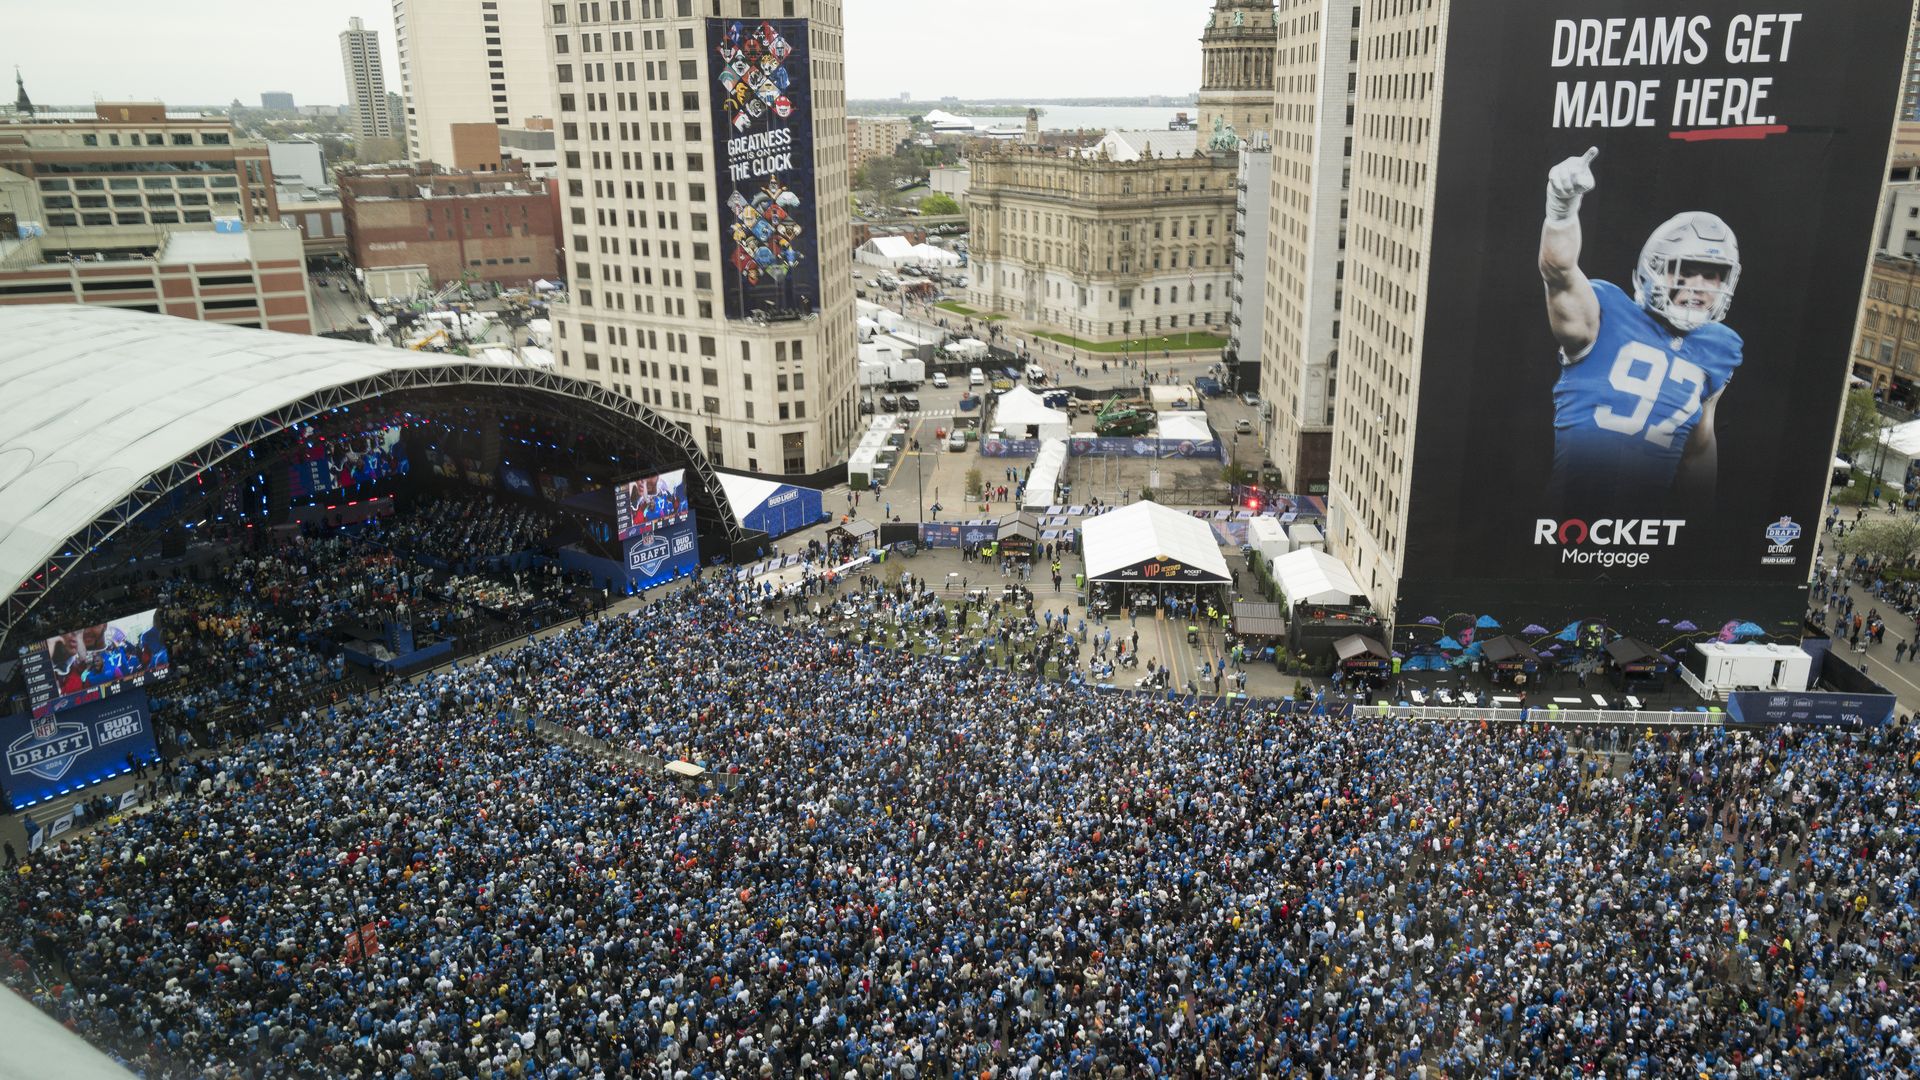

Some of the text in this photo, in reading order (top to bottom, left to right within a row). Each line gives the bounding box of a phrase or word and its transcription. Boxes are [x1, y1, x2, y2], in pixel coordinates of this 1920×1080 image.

[1551, 13, 1803, 67] DREAMS GET
[1552, 77, 1777, 128] MADE HERE.
[727, 127, 791, 156] GREATNESS
[747, 148, 771, 160] IS ON
[728, 152, 793, 181] THE CLOCK
[1593, 340, 1706, 449] 97
[781, 490, 797, 502] LIGHT
[1534, 518, 1686, 545] ROCKET
[673, 541, 692, 553] LIGHT
[676, 536, 690, 546] BUD
[1767, 544, 1794, 553] DETROIT
[633, 546, 666, 564] DRAFT
[1562, 548, 1650, 568] Mortgage
[1144, 563, 1160, 577] VIP
[152, 668, 168, 677] WAS
[35, 724, 55, 738] NFL
[103, 715, 133, 732] BUD
[100, 722, 139, 743] LIGHT
[15, 735, 83, 767] DRAFT
[45, 760, 62, 769] 2024
